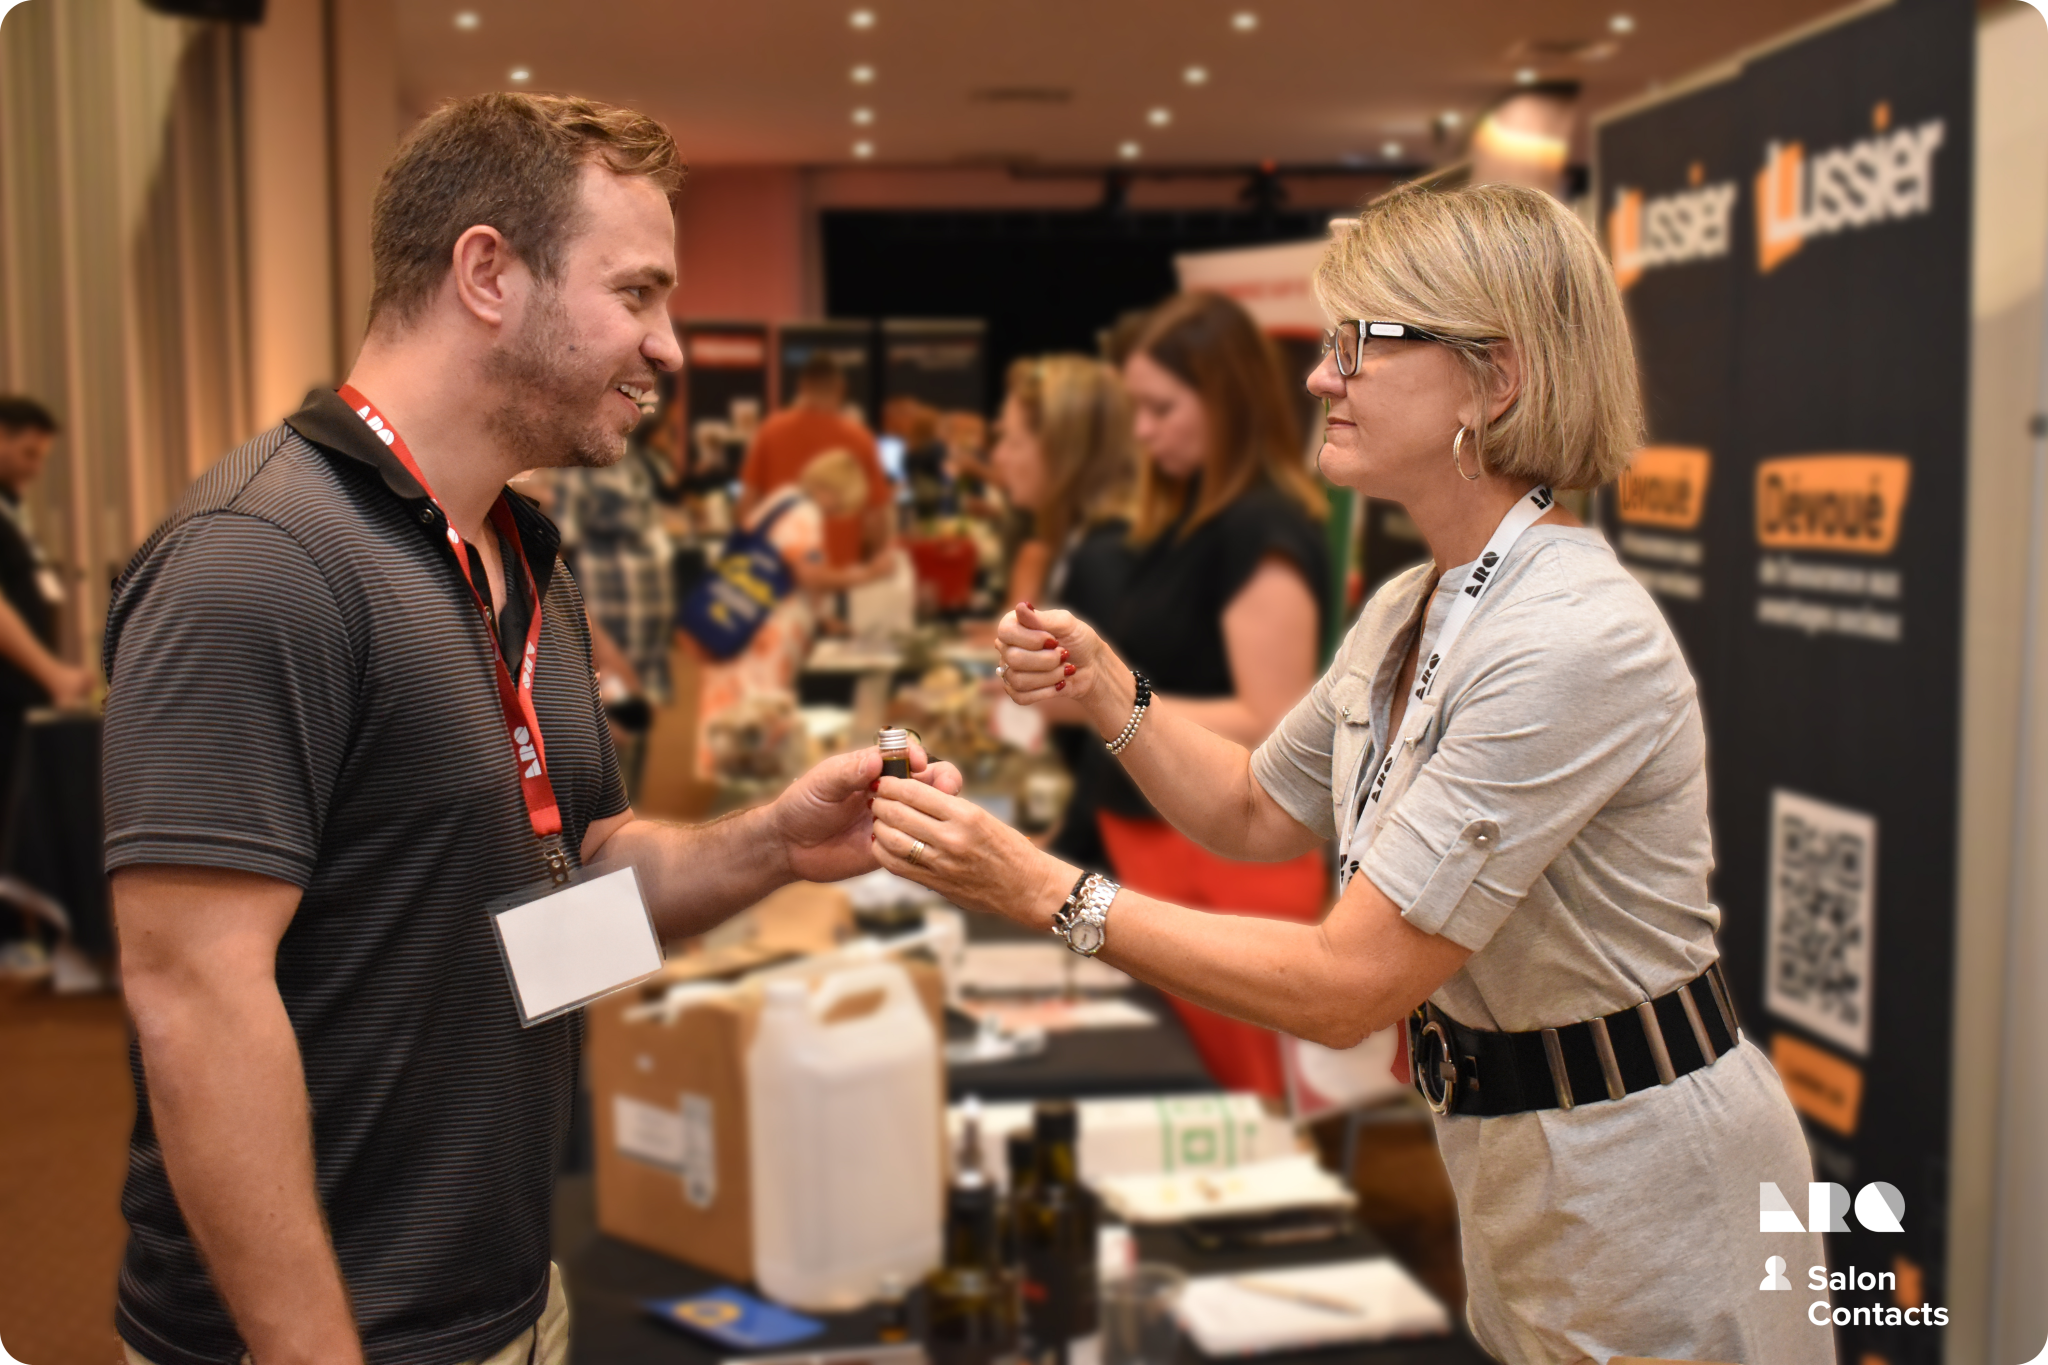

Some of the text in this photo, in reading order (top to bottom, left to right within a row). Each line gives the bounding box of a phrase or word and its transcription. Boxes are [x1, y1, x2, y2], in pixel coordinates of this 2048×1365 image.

[1758, 104, 1943, 268] Lussier
[1464, 551, 1500, 598] ARQ
[514, 726, 542, 778] ARQ
